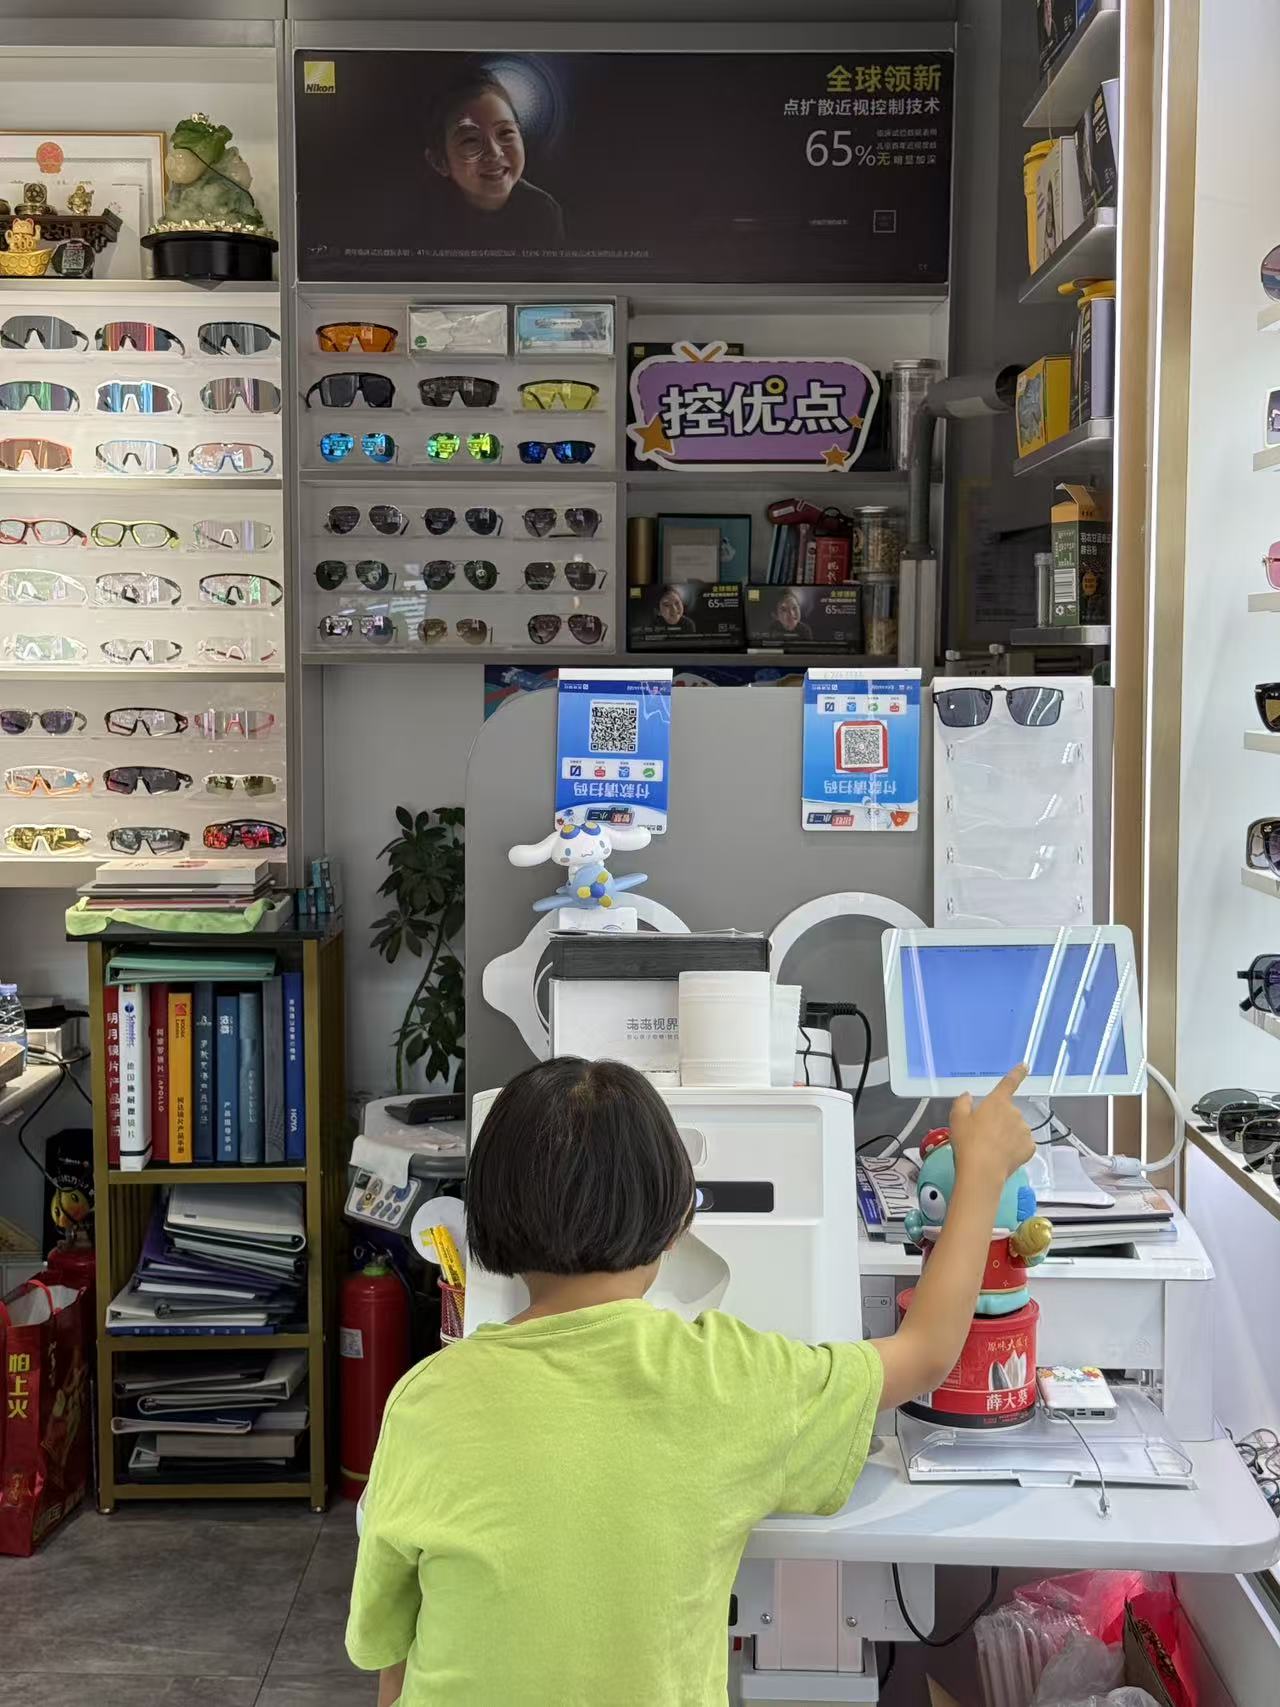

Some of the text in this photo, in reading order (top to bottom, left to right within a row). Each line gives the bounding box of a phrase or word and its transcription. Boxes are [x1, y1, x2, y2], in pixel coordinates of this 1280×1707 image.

[306, 83, 334, 93] Nikon
[826, 64, 942, 93] 全球领新
[783, 97, 941, 116] 点扩散近视控制技术
[805, 130, 876, 167] 65%
[661, 377, 850, 437] 控优点
[573, 782, 650, 799] 付款请扫码
[823, 780, 897, 794] 付款请扫码
[290, 1108, 298, 1132] HOYA
[8, 1353, 30, 1419] 怕上火
[986, 1390, 1029, 1412] 薛大葵
